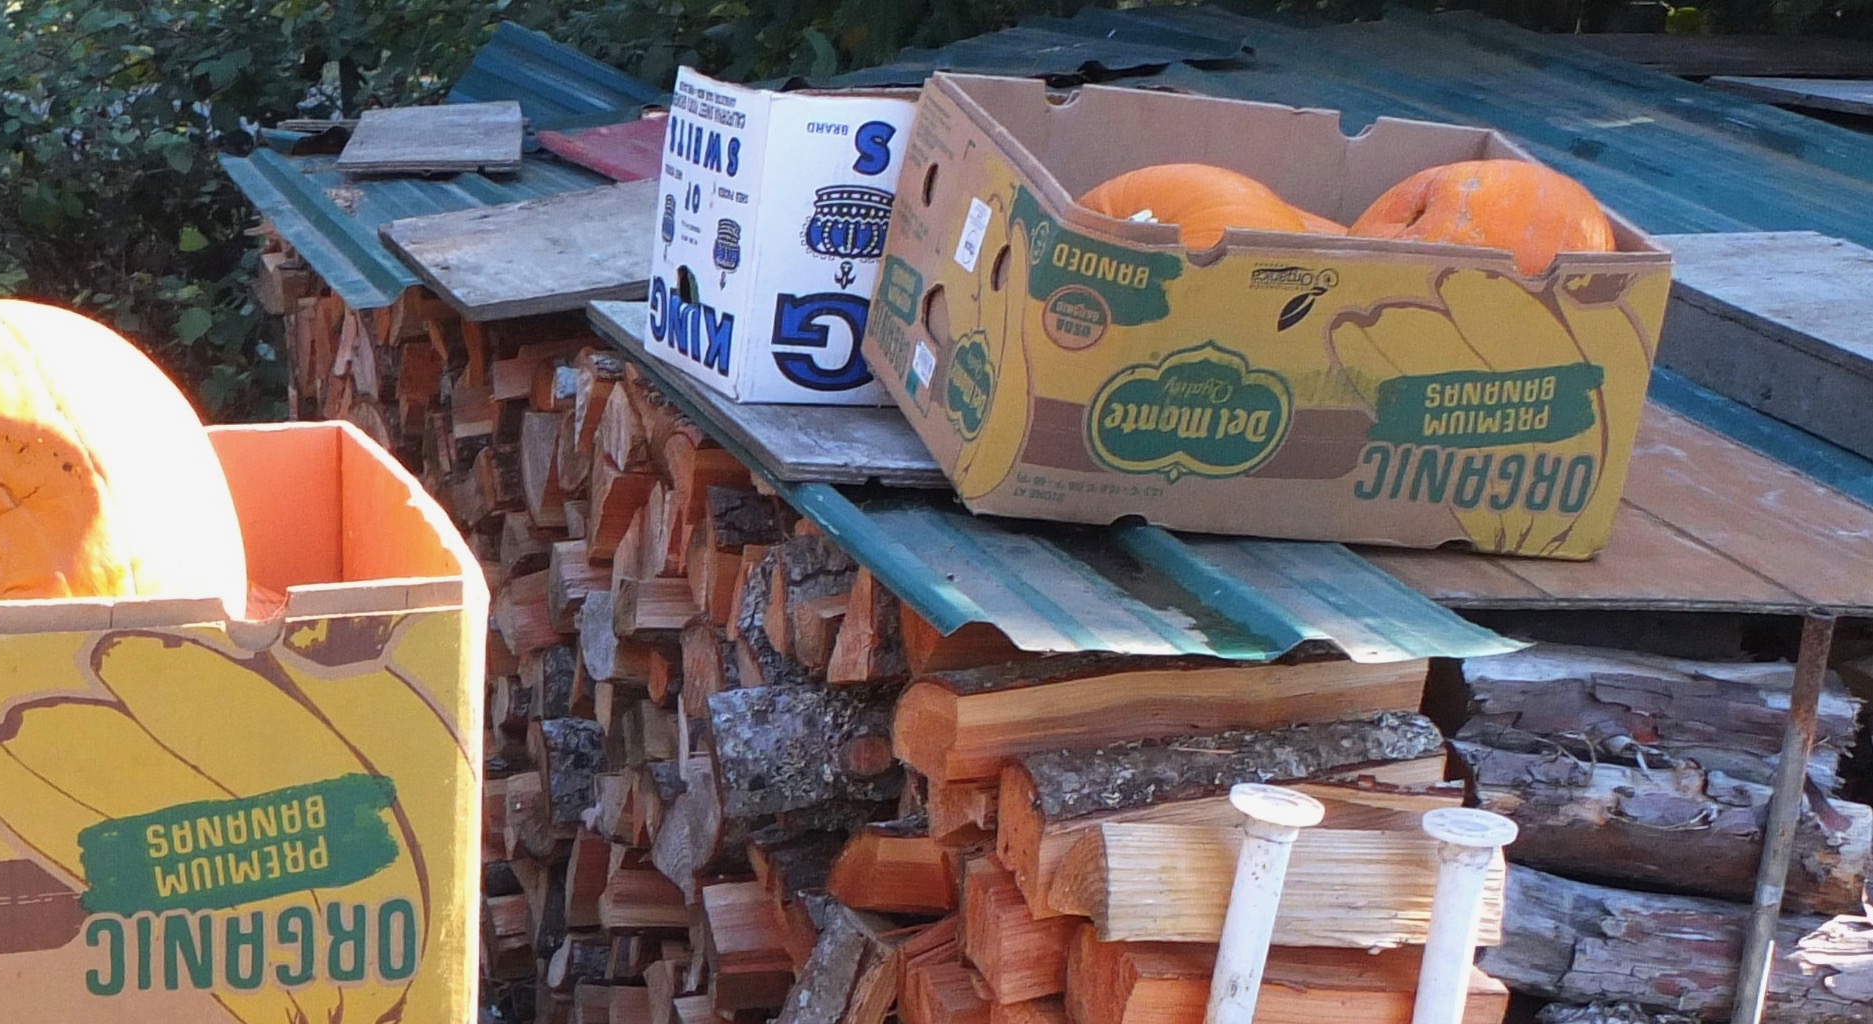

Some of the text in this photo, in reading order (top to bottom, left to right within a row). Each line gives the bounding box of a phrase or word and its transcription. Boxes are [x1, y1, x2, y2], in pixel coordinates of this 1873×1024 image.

[807, 122, 848, 136] BRAND
[1052, 243, 1149, 288] BANDED
[650, 276, 734, 377] KING
[1425, 376, 1556, 407] BANANAS
[1104, 403, 1271, 442] Del Monte
[1423, 405, 1549, 436] PREMIUM
[1354, 444, 1594, 514] ORGANIC
[145, 795, 328, 858] BANANAS
[153, 835, 330, 898] PREMIUM
[85, 899, 416, 996] ORGANIC
